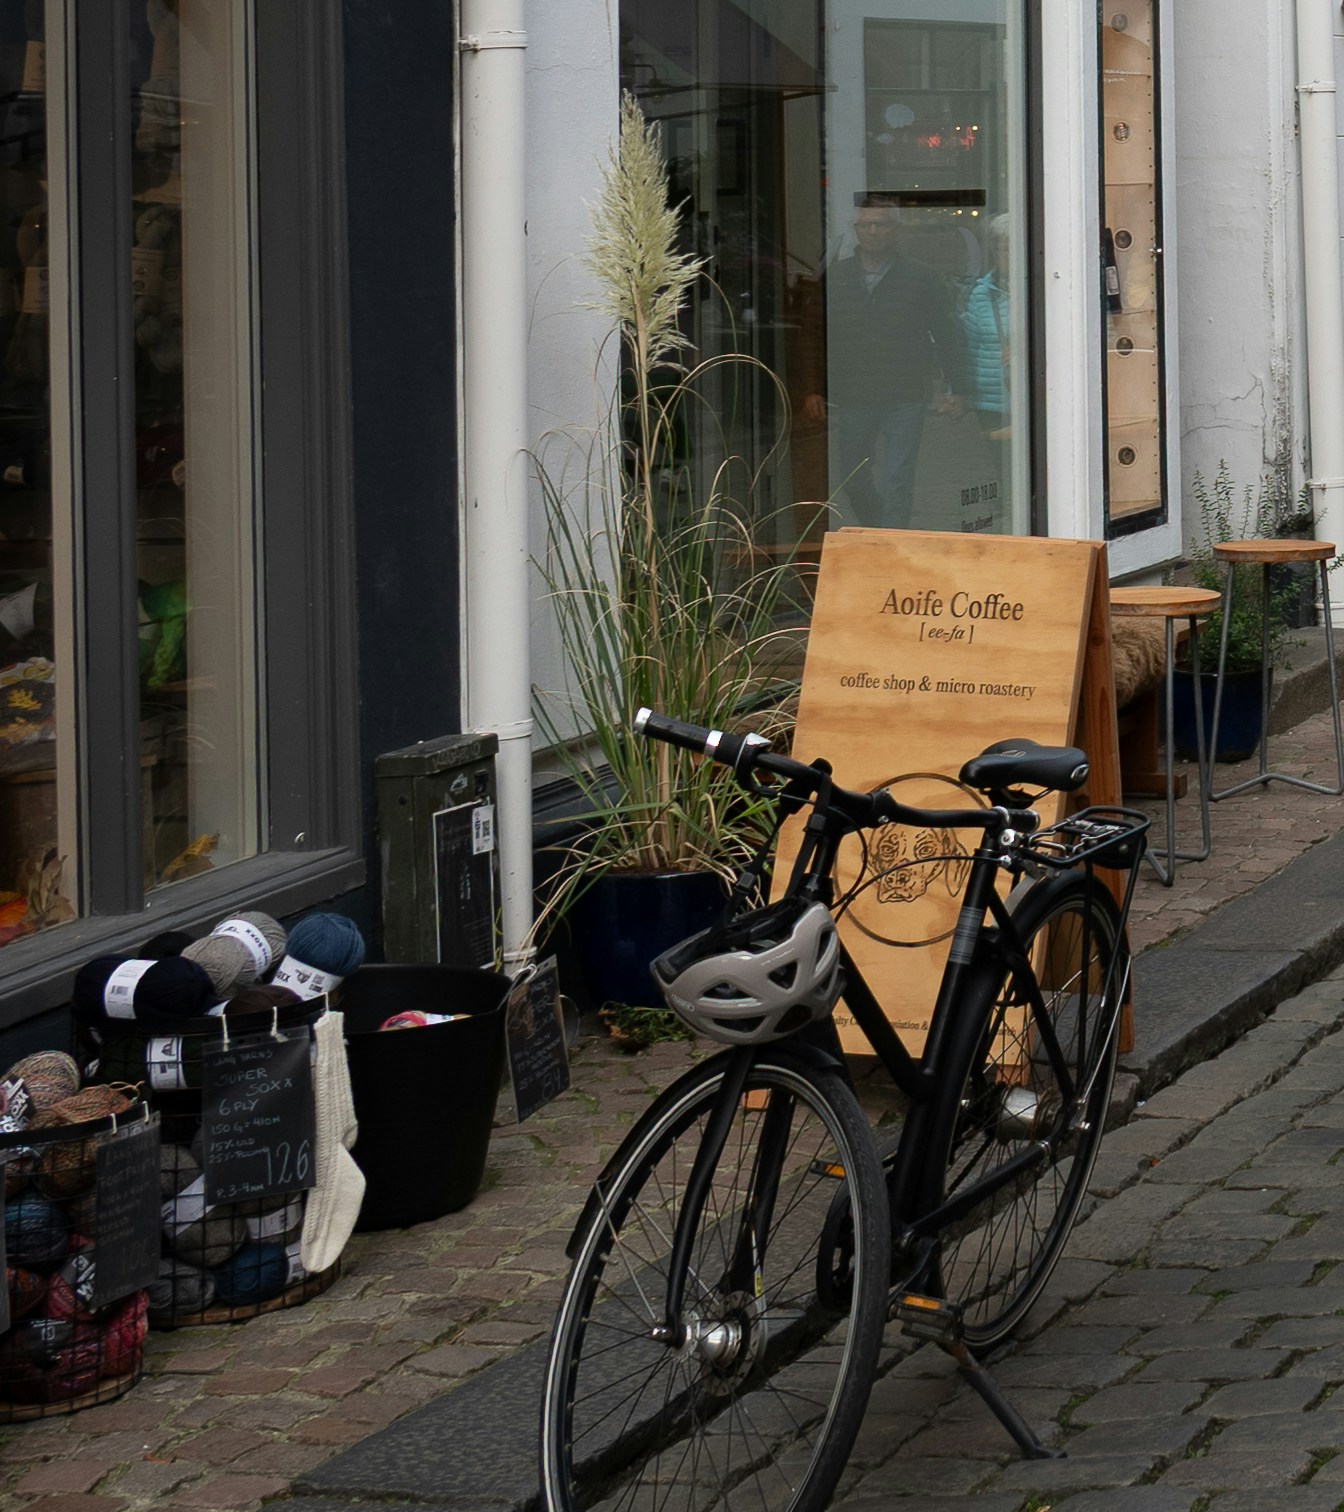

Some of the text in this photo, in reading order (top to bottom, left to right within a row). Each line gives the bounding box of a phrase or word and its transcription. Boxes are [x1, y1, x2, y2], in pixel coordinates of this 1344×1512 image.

[879, 588, 1024, 621] Aoife Coffee
[840, 672, 1037, 701] coffee shop & micro roastery
[245, 1077, 293, 1097] SOXX
